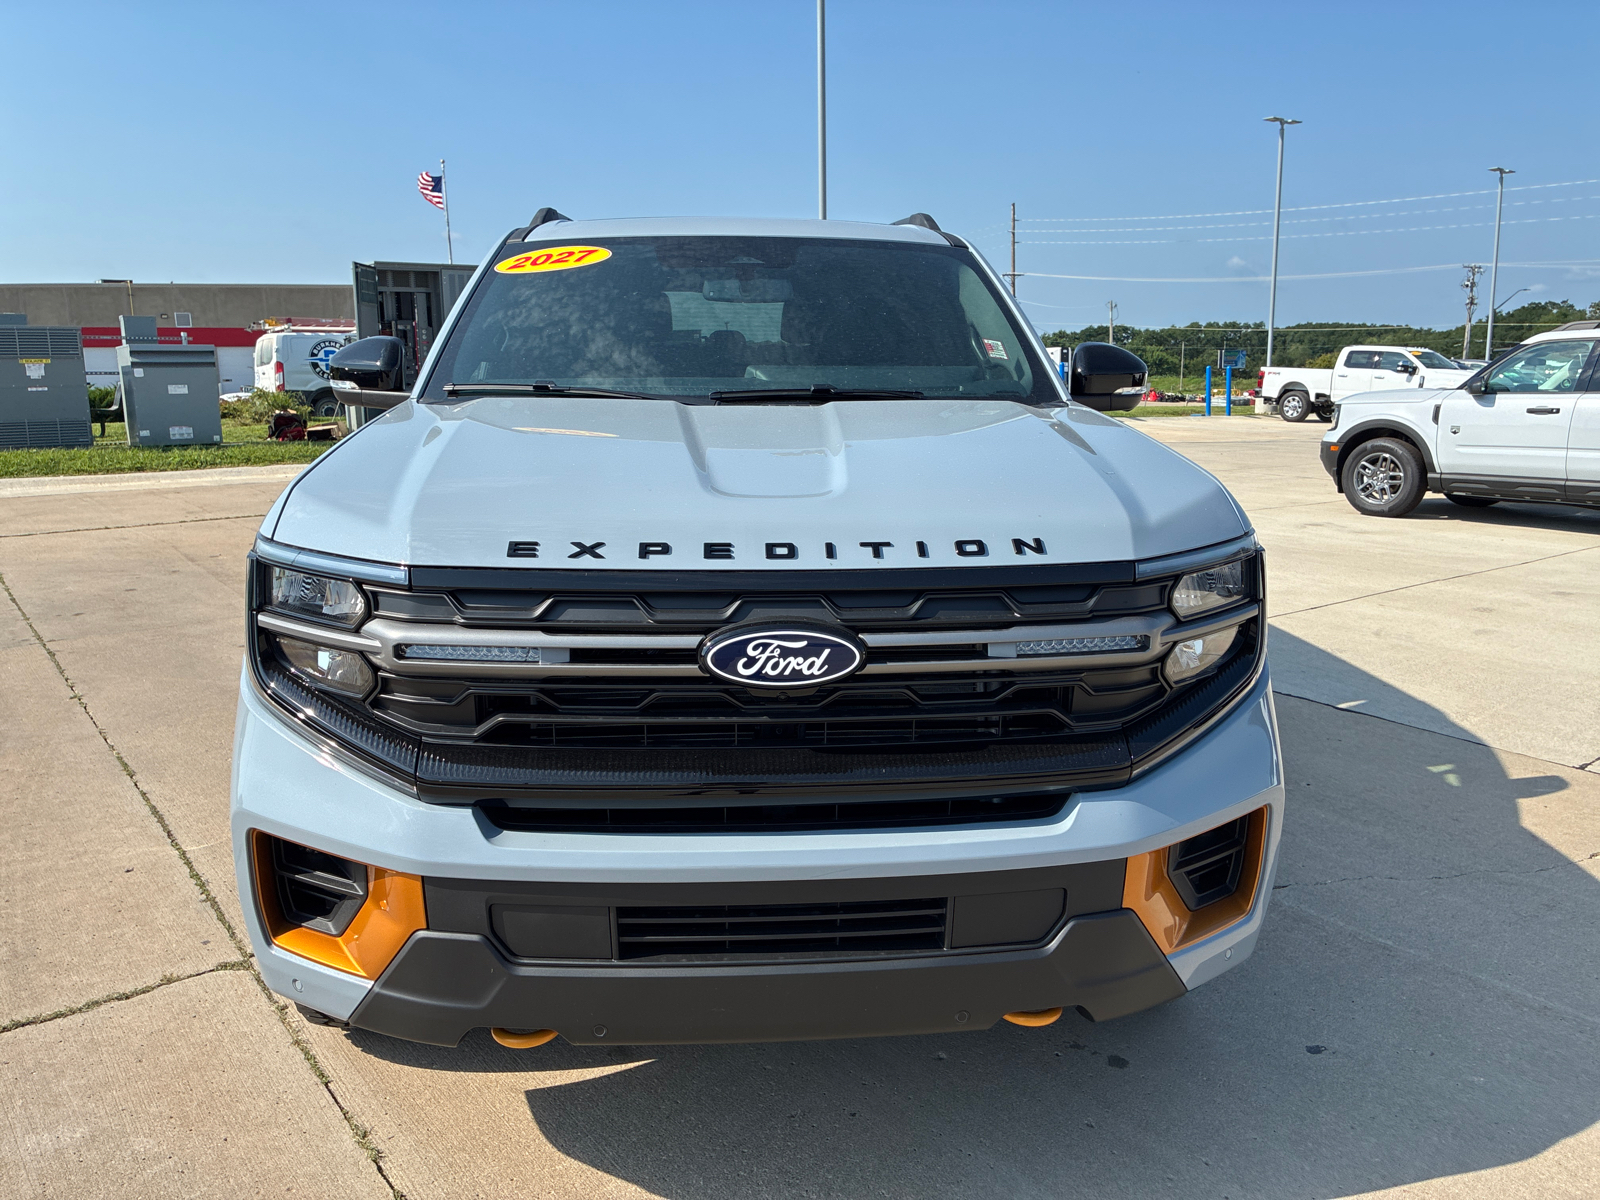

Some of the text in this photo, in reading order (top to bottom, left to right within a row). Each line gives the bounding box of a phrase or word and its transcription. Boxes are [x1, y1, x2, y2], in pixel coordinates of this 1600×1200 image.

[505, 249, 600, 271] 2027
[312, 341, 341, 355] BURKHE
[506, 538, 1047, 560] EXPEDITION
[736, 639, 831, 676] Ford
